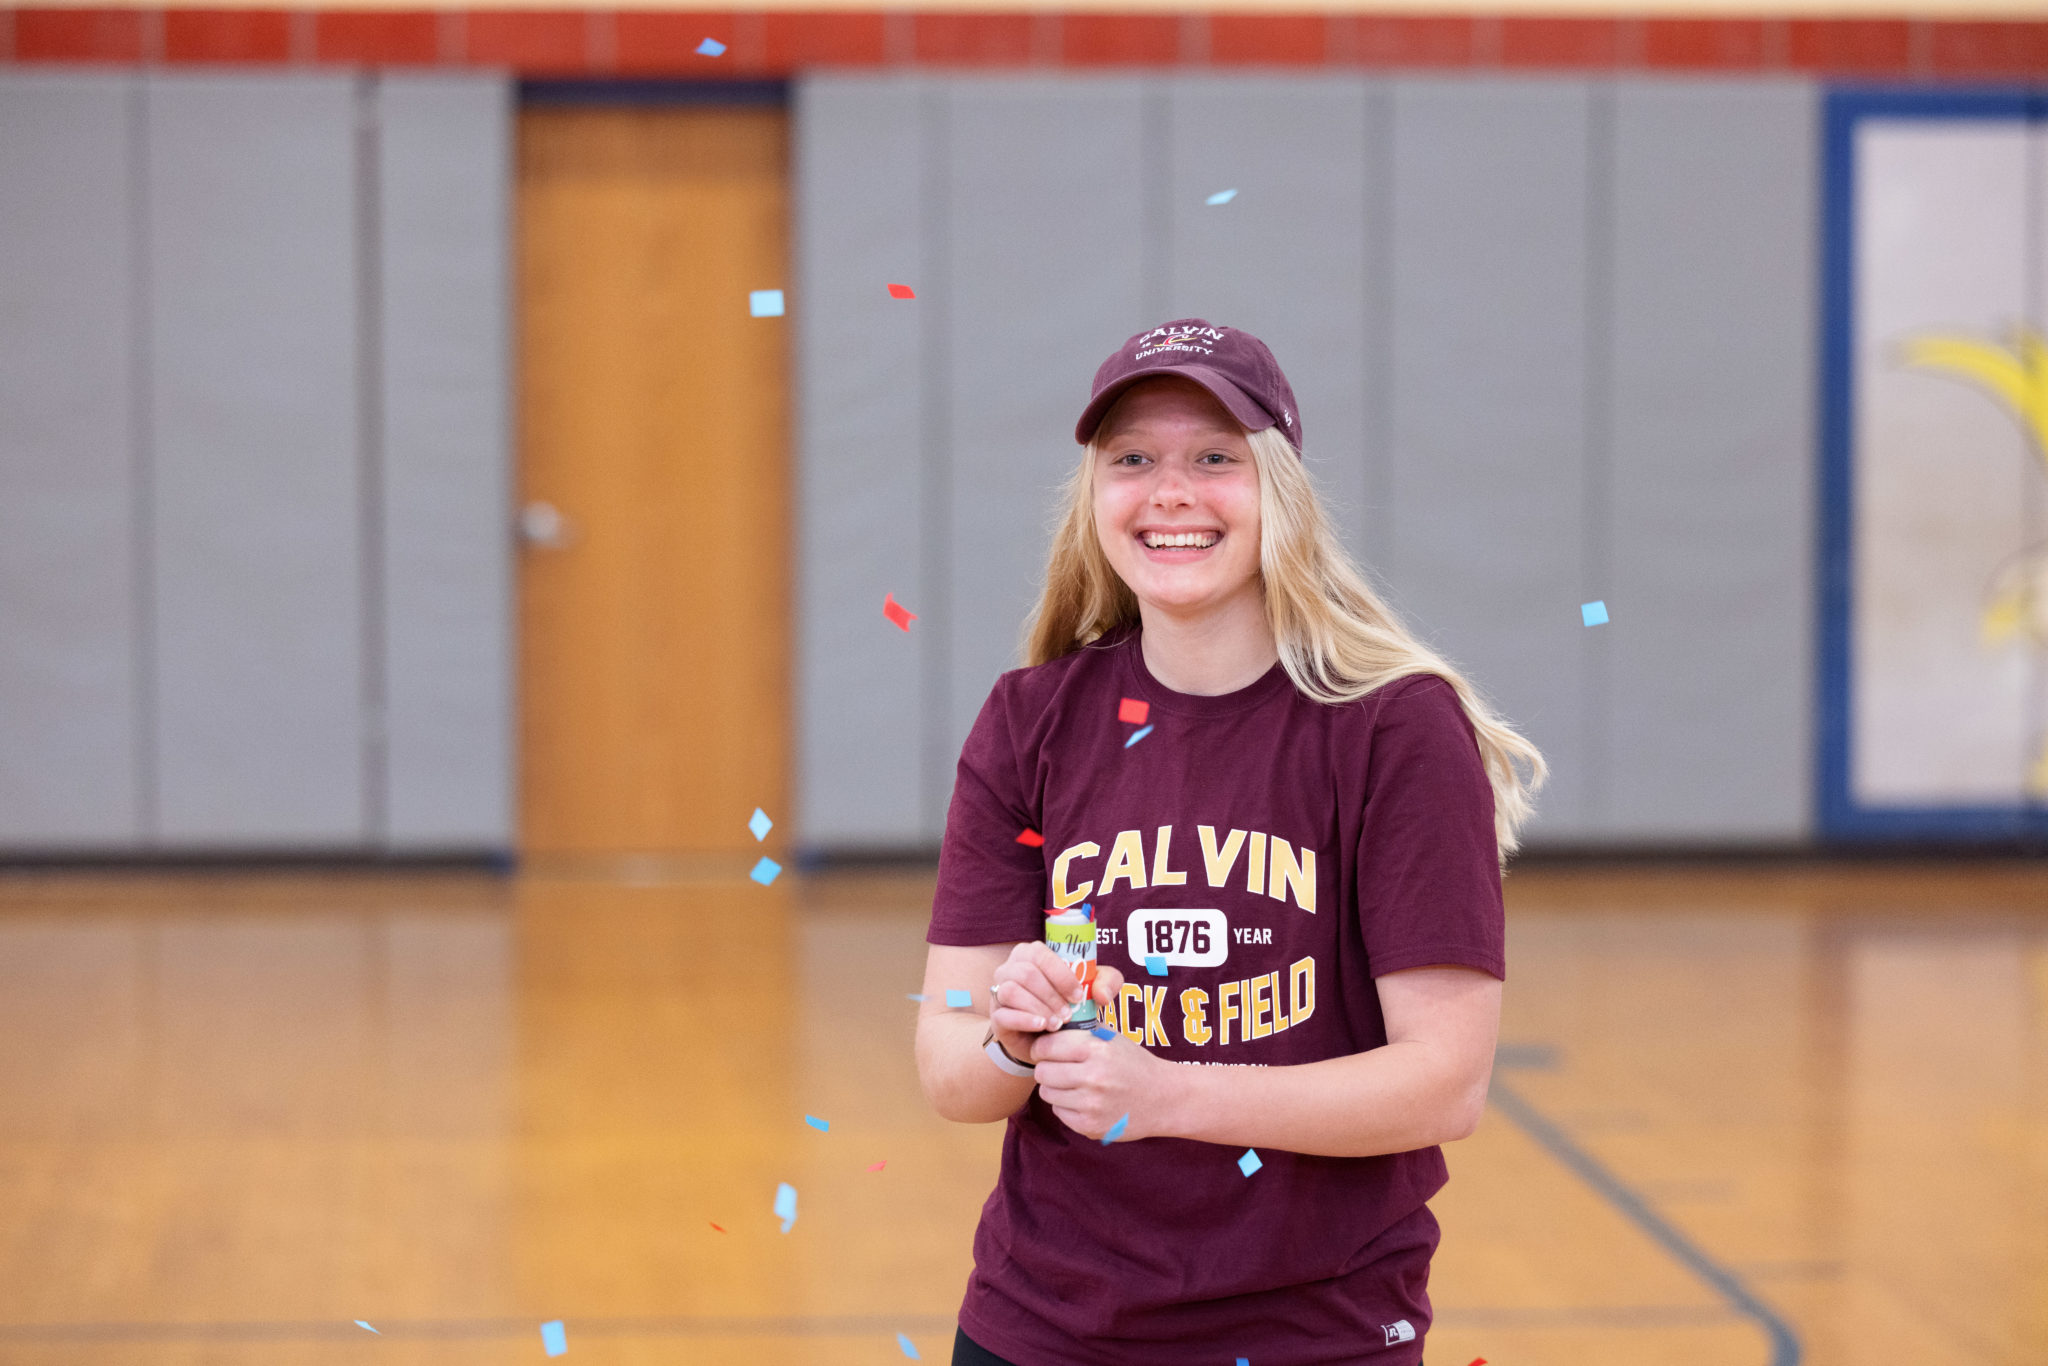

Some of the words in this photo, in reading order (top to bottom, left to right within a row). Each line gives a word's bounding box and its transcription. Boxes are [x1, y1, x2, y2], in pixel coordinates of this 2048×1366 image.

[1139, 326, 1225, 344] CALVIN
[1135, 345, 1214, 360] UNIVERSITY
[1052, 825, 1317, 915] CALVIN
[1065, 933, 1092, 959] Hip
[1096, 928, 1123, 945] EST.
[1144, 920, 1212, 954] 1876
[1233, 928, 1272, 945] YEAR
[1179, 987, 1213, 1047] &
[1219, 956, 1316, 1046] FIELD
